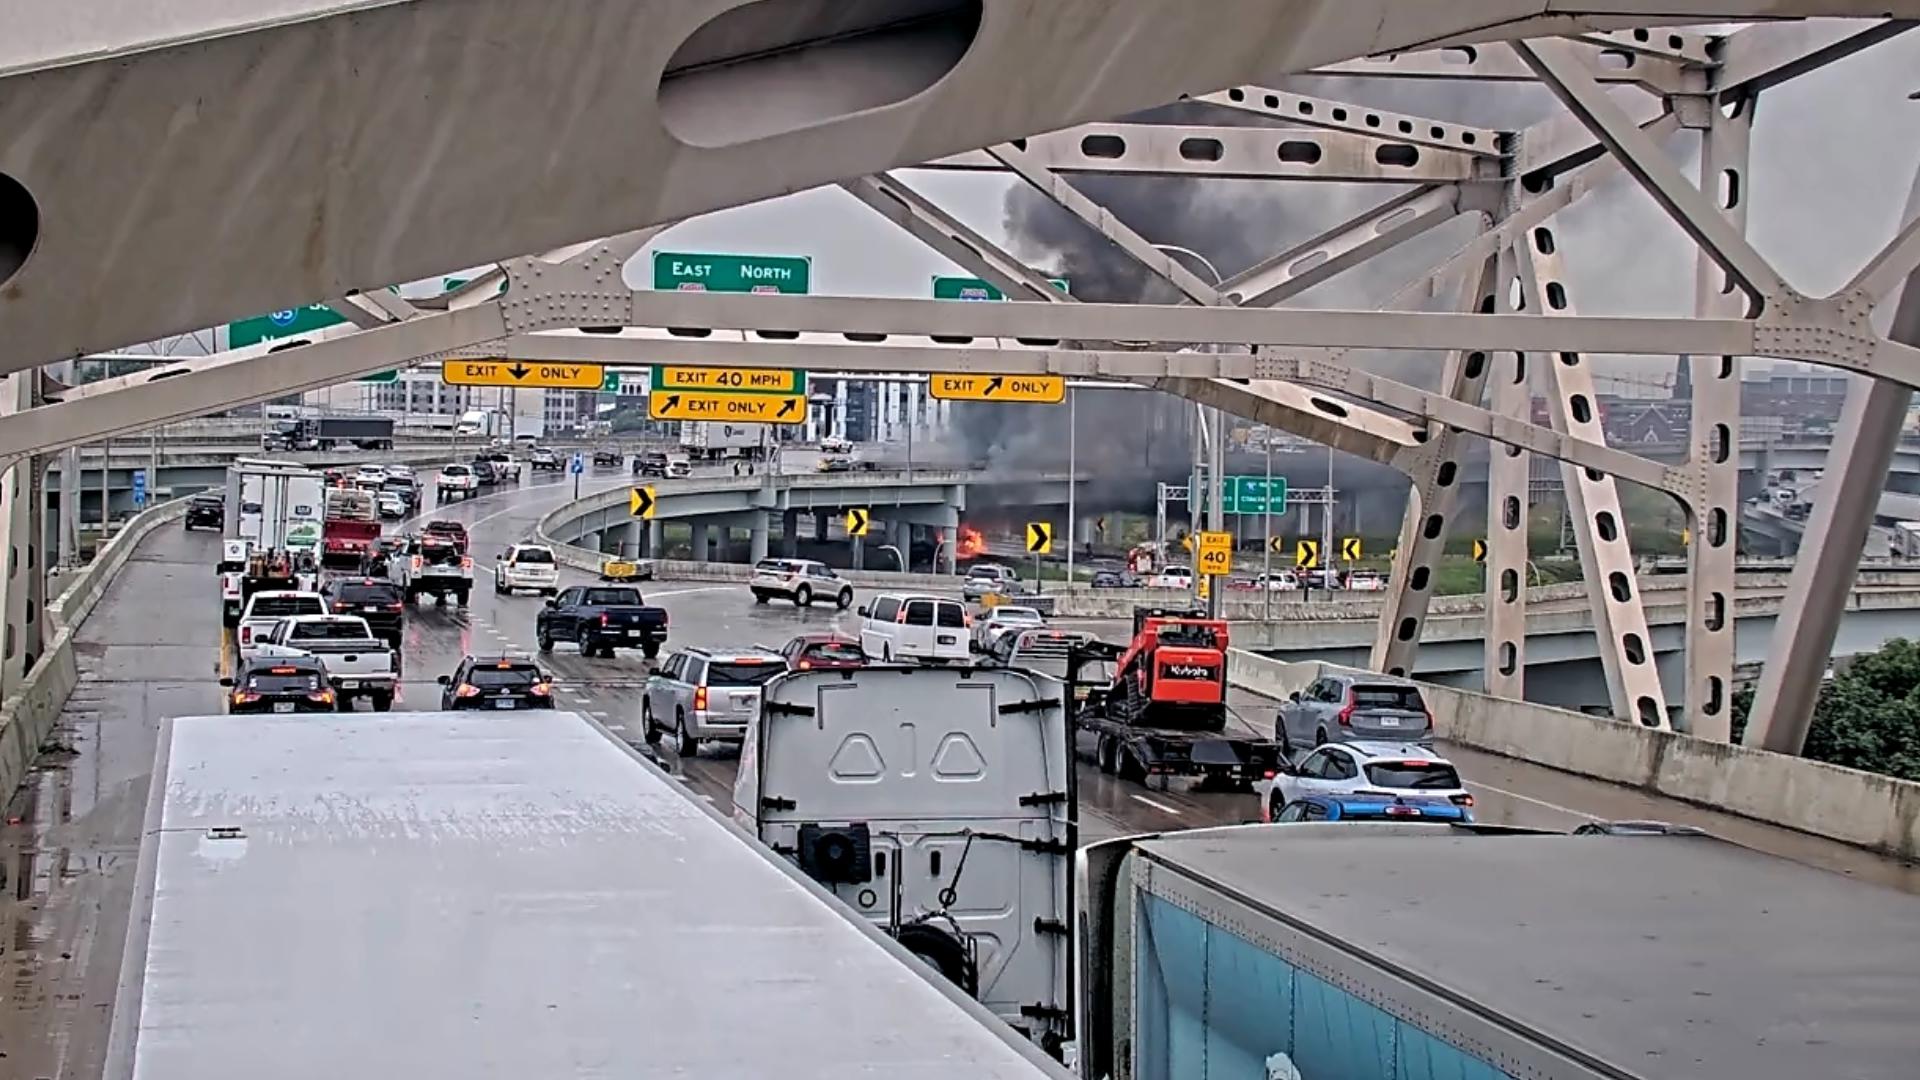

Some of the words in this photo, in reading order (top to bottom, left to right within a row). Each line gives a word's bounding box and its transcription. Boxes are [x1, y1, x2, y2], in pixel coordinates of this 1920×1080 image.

[672, 261, 711, 276] EAST
[740, 264, 791, 280] NORTH
[466, 365, 498, 377] EXIT
[541, 367, 581, 379] ONLY
[676, 371, 708, 383] EXIT
[716, 371, 743, 387] 40
[751, 374, 781, 386] MPH
[944, 379, 975, 391] EXIT
[1011, 381, 1050, 393] ONLY
[688, 400, 719, 411] EXIT
[727, 401, 766, 413] ONLY
[1204, 551, 1226, 563] 40
[1171, 665, 1208, 676] Kubota
